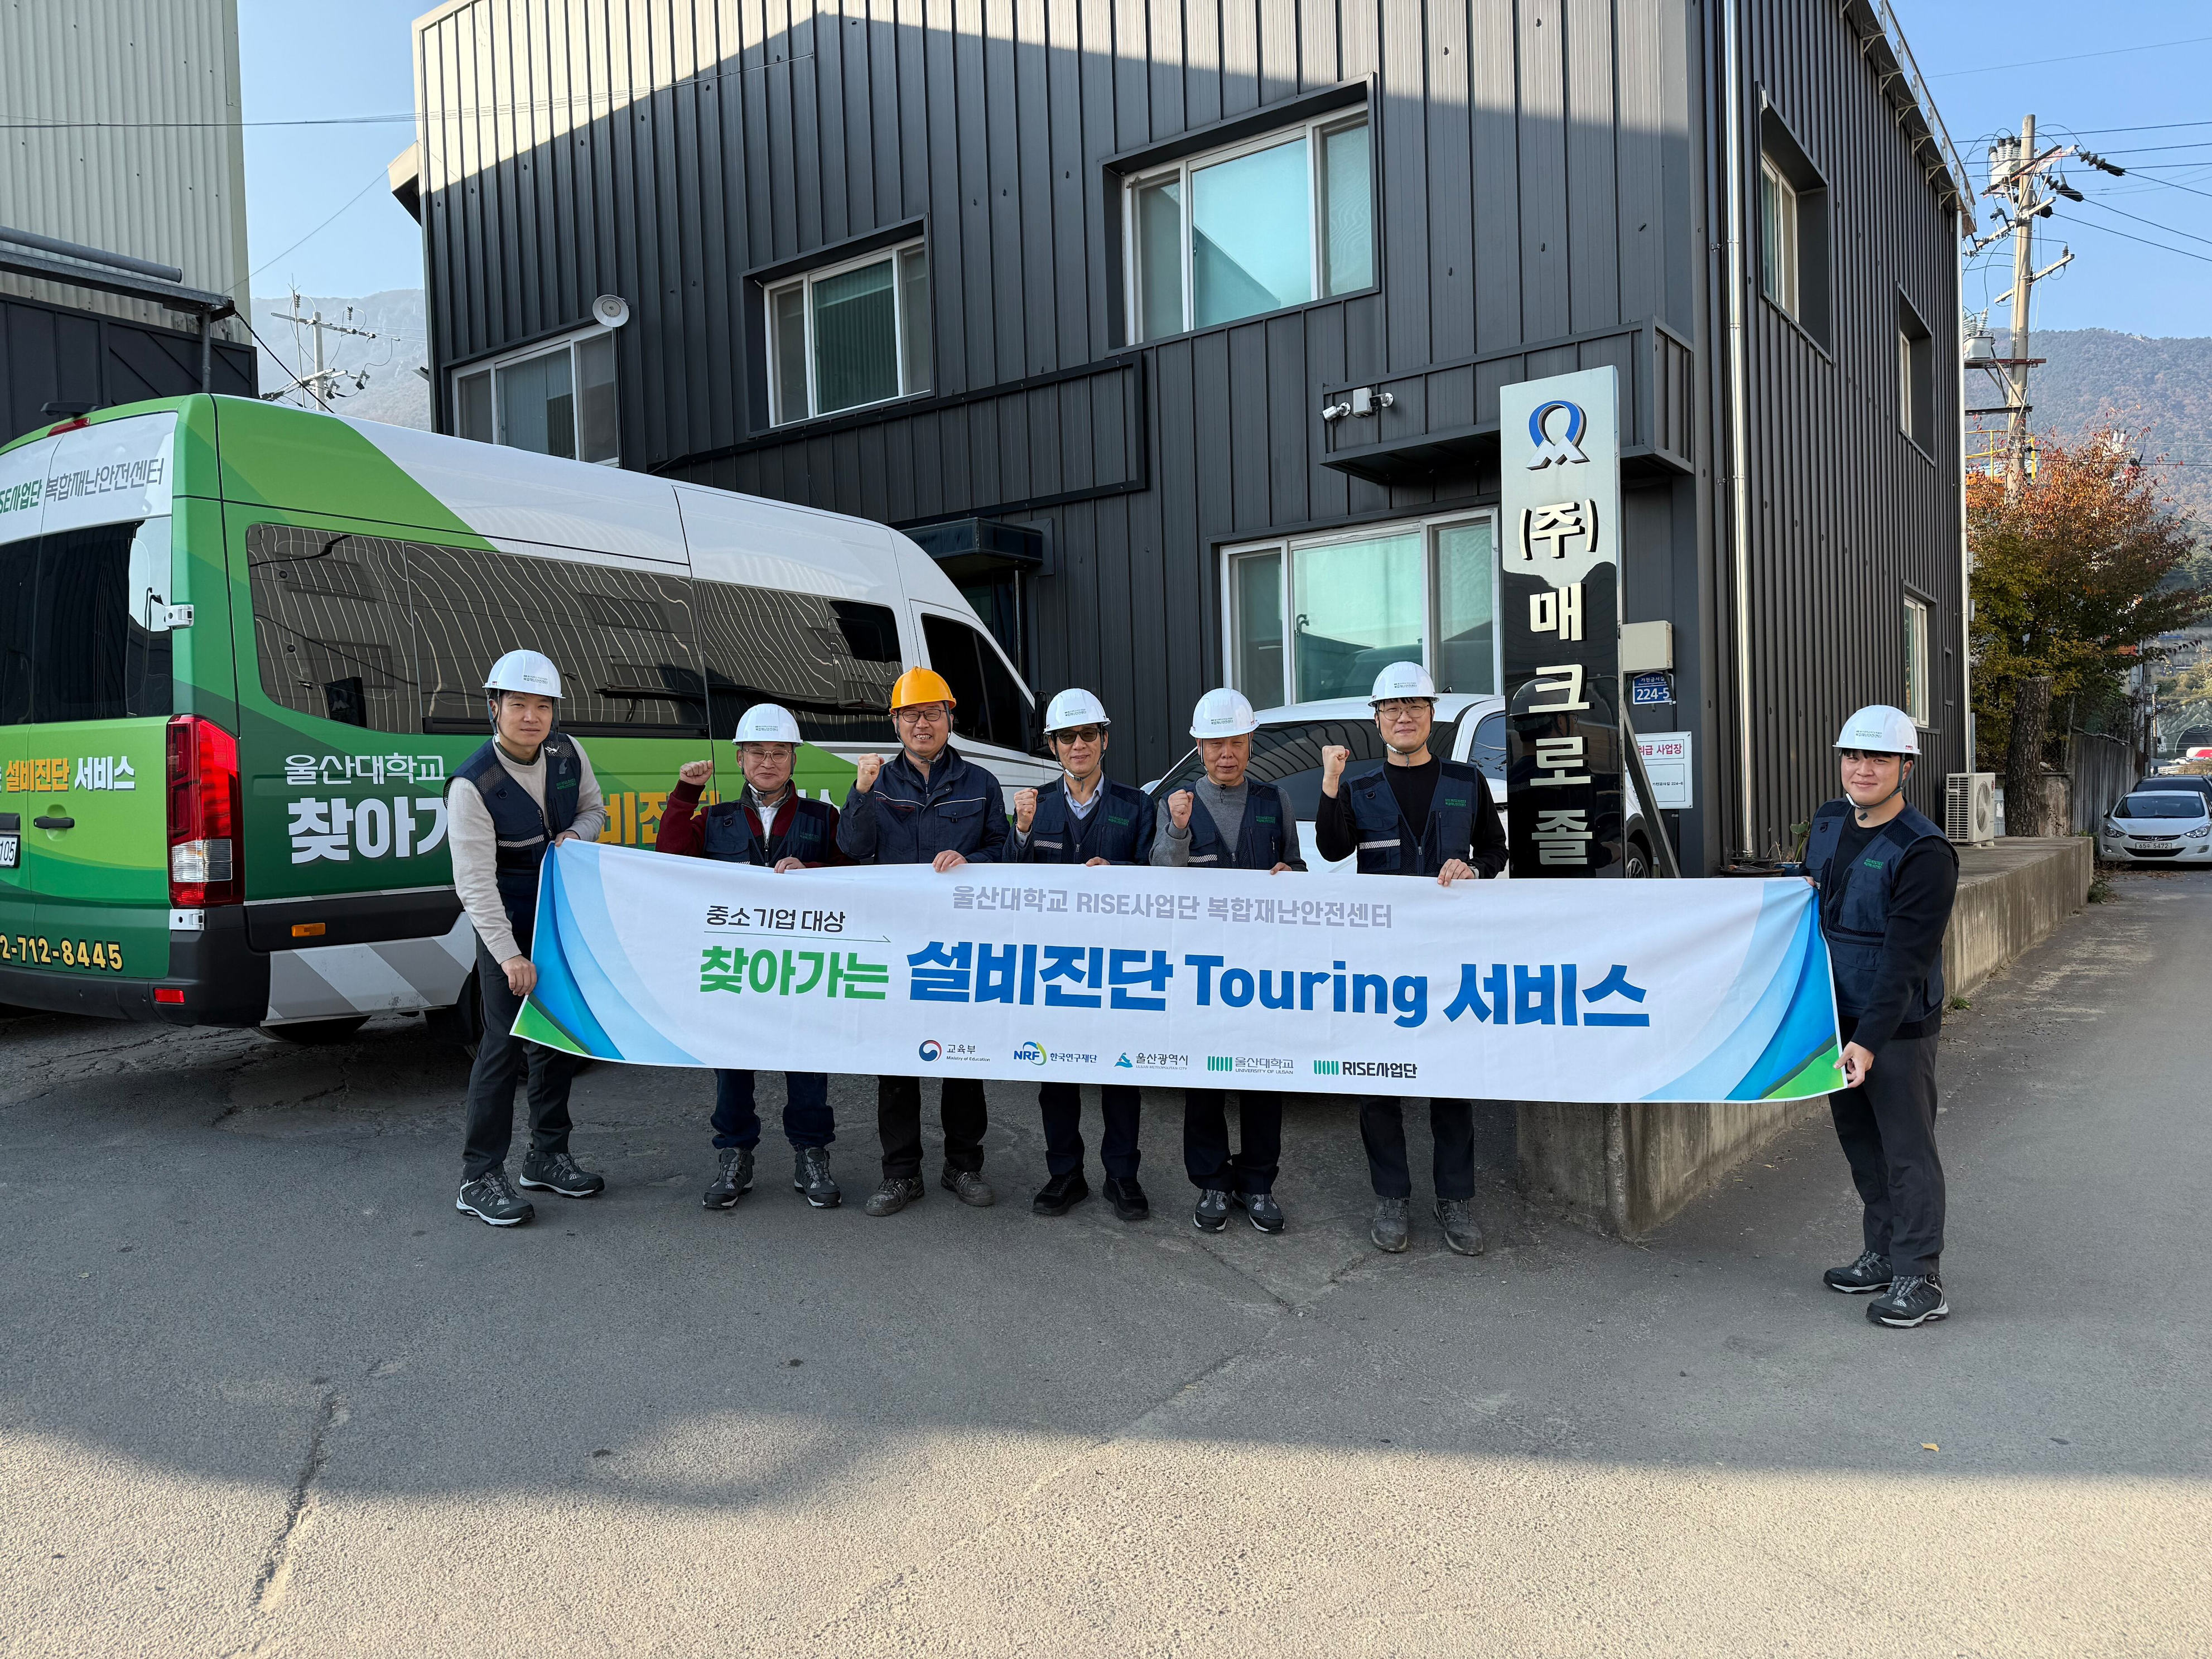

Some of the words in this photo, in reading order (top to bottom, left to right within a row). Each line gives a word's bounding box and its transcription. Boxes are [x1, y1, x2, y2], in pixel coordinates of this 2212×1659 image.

[46, 458, 164, 501] 복합재난안전센터
[1636, 687, 1670, 701] 224-5
[1656, 744, 1682, 755] 사업장
[6, 758, 70, 792] 설비진단
[74, 756, 135, 790] 서비스
[285, 752, 445, 785] 울산대학교
[952, 885, 1068, 913] 울산대학교
[1076, 892, 1200, 920] RISE사업단
[1207, 896, 1391, 928] 복합재난안전센터
[801, 910, 846, 933] 대상
[700, 946, 889, 1000] 찾아가는
[907, 941, 1173, 1011] 설비진단
[1185, 954, 1428, 1028] Touring
[1443, 964, 1650, 1027] 서비스
[947, 1044, 976, 1054] 교육부
[1014, 1050, 1040, 1060] NRF
[1050, 1052, 1098, 1063] 한국연구재단
[1135, 1053, 1188, 1066] 울산광역시
[1235, 1057, 1294, 1069] 울산대학교
[1342, 1062, 1418, 1078] RISE사업단
